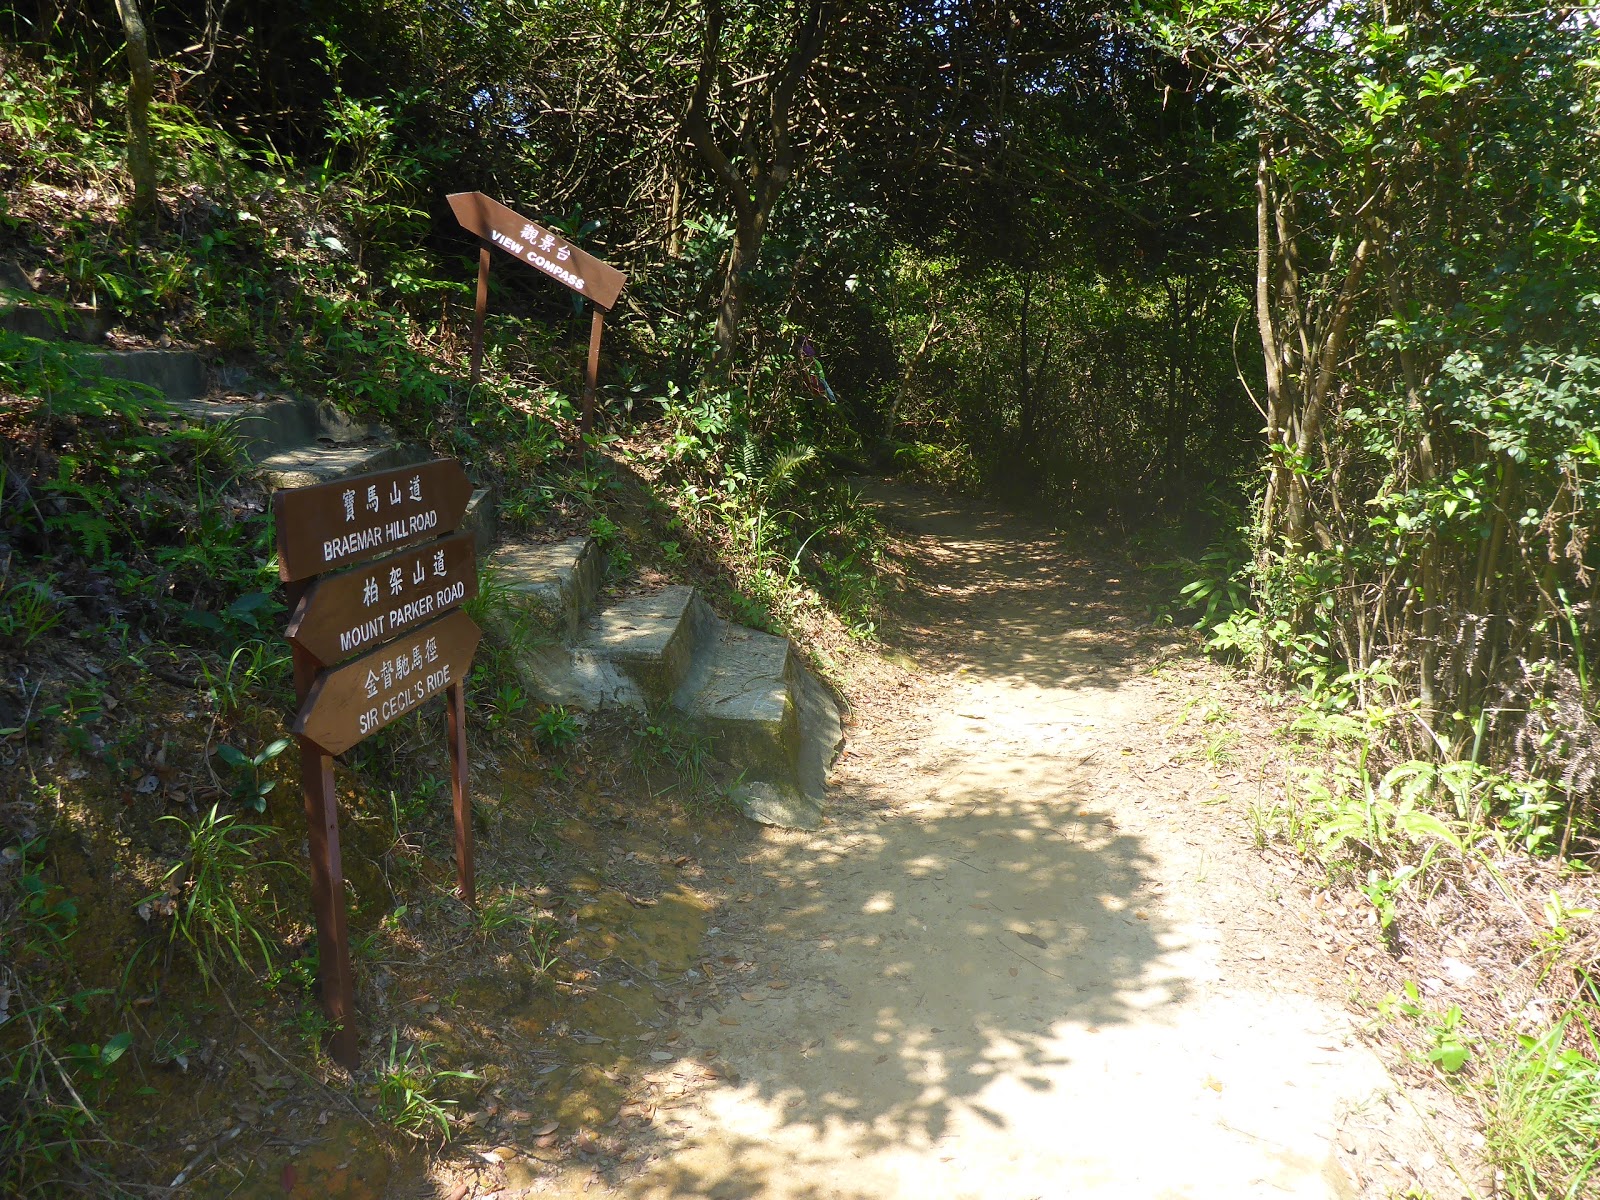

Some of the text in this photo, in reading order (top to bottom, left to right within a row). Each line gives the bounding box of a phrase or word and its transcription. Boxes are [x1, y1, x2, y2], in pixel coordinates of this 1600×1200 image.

[491, 230, 585, 290] VIEW COMPASS
[342, 474, 423, 522] 寶馬山道
[323, 509, 437, 561] BRAEMAR HILL ROAD
[363, 549, 448, 607] 柏架山道
[340, 581, 465, 652] MOUNT PARKER ROAD
[359, 664, 451, 735] SIR CECIL'S RIDE
